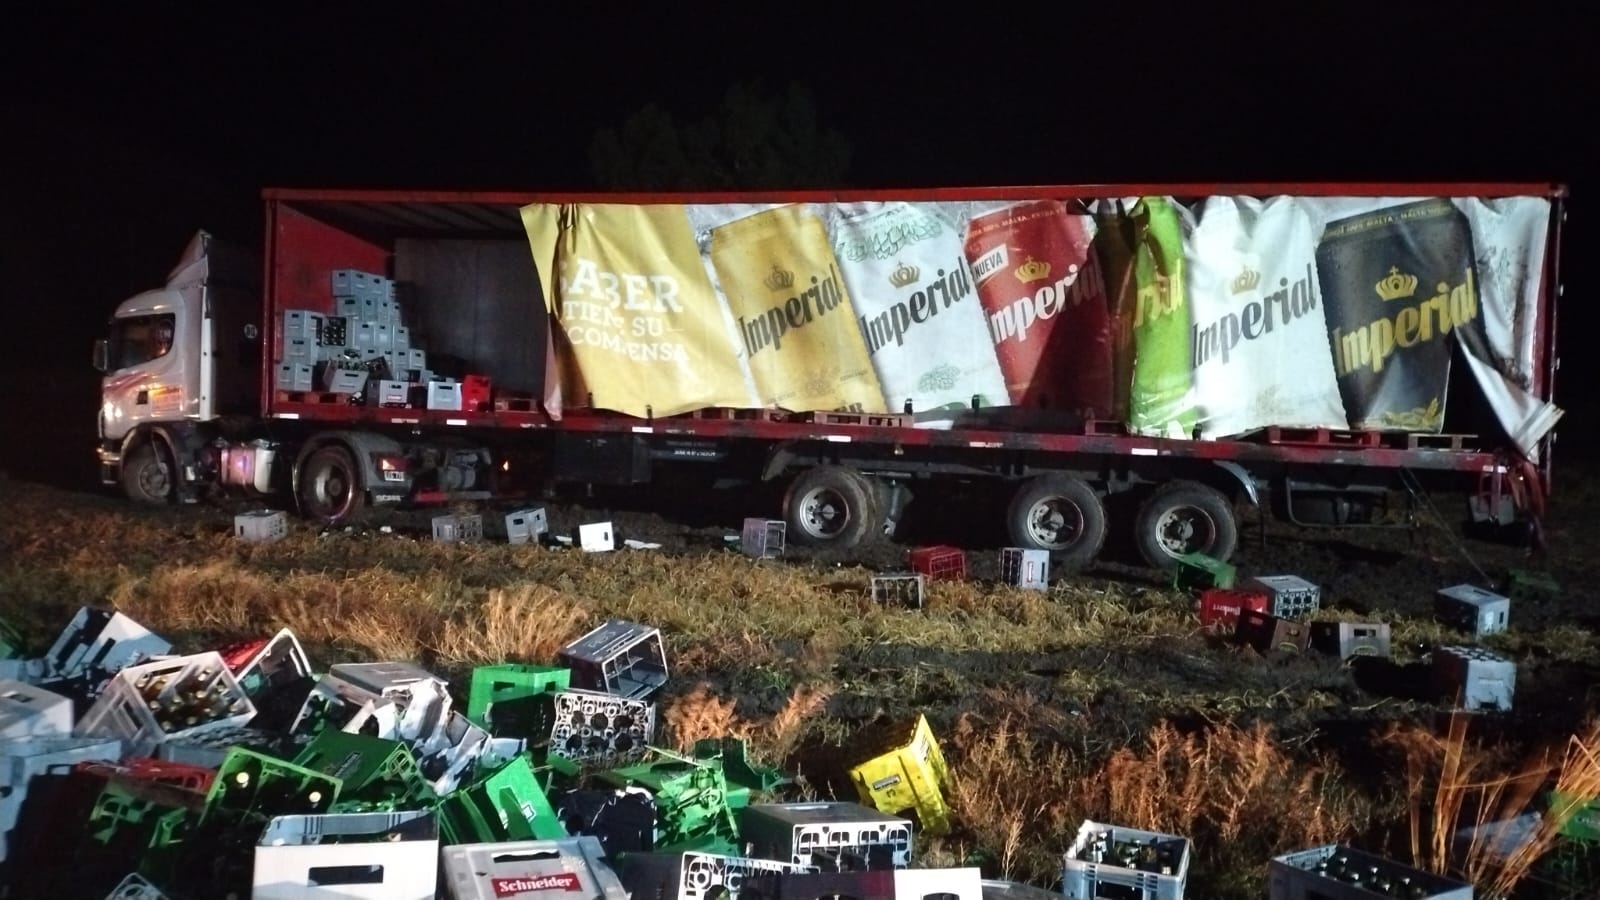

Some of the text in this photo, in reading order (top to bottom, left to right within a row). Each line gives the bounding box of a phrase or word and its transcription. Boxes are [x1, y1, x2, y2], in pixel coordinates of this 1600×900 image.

[561, 258, 684, 312] ABER
[974, 251, 1003, 282] NUEVA
[631, 316, 664, 337] SU
[738, 263, 845, 358] Imperial
[860, 256, 971, 357] Imperial
[1192, 263, 1317, 371] Imperial
[1332, 267, 1477, 378] Imperial
[567, 326, 690, 363] COMENSA
[499, 877, 573, 893] Schneider
